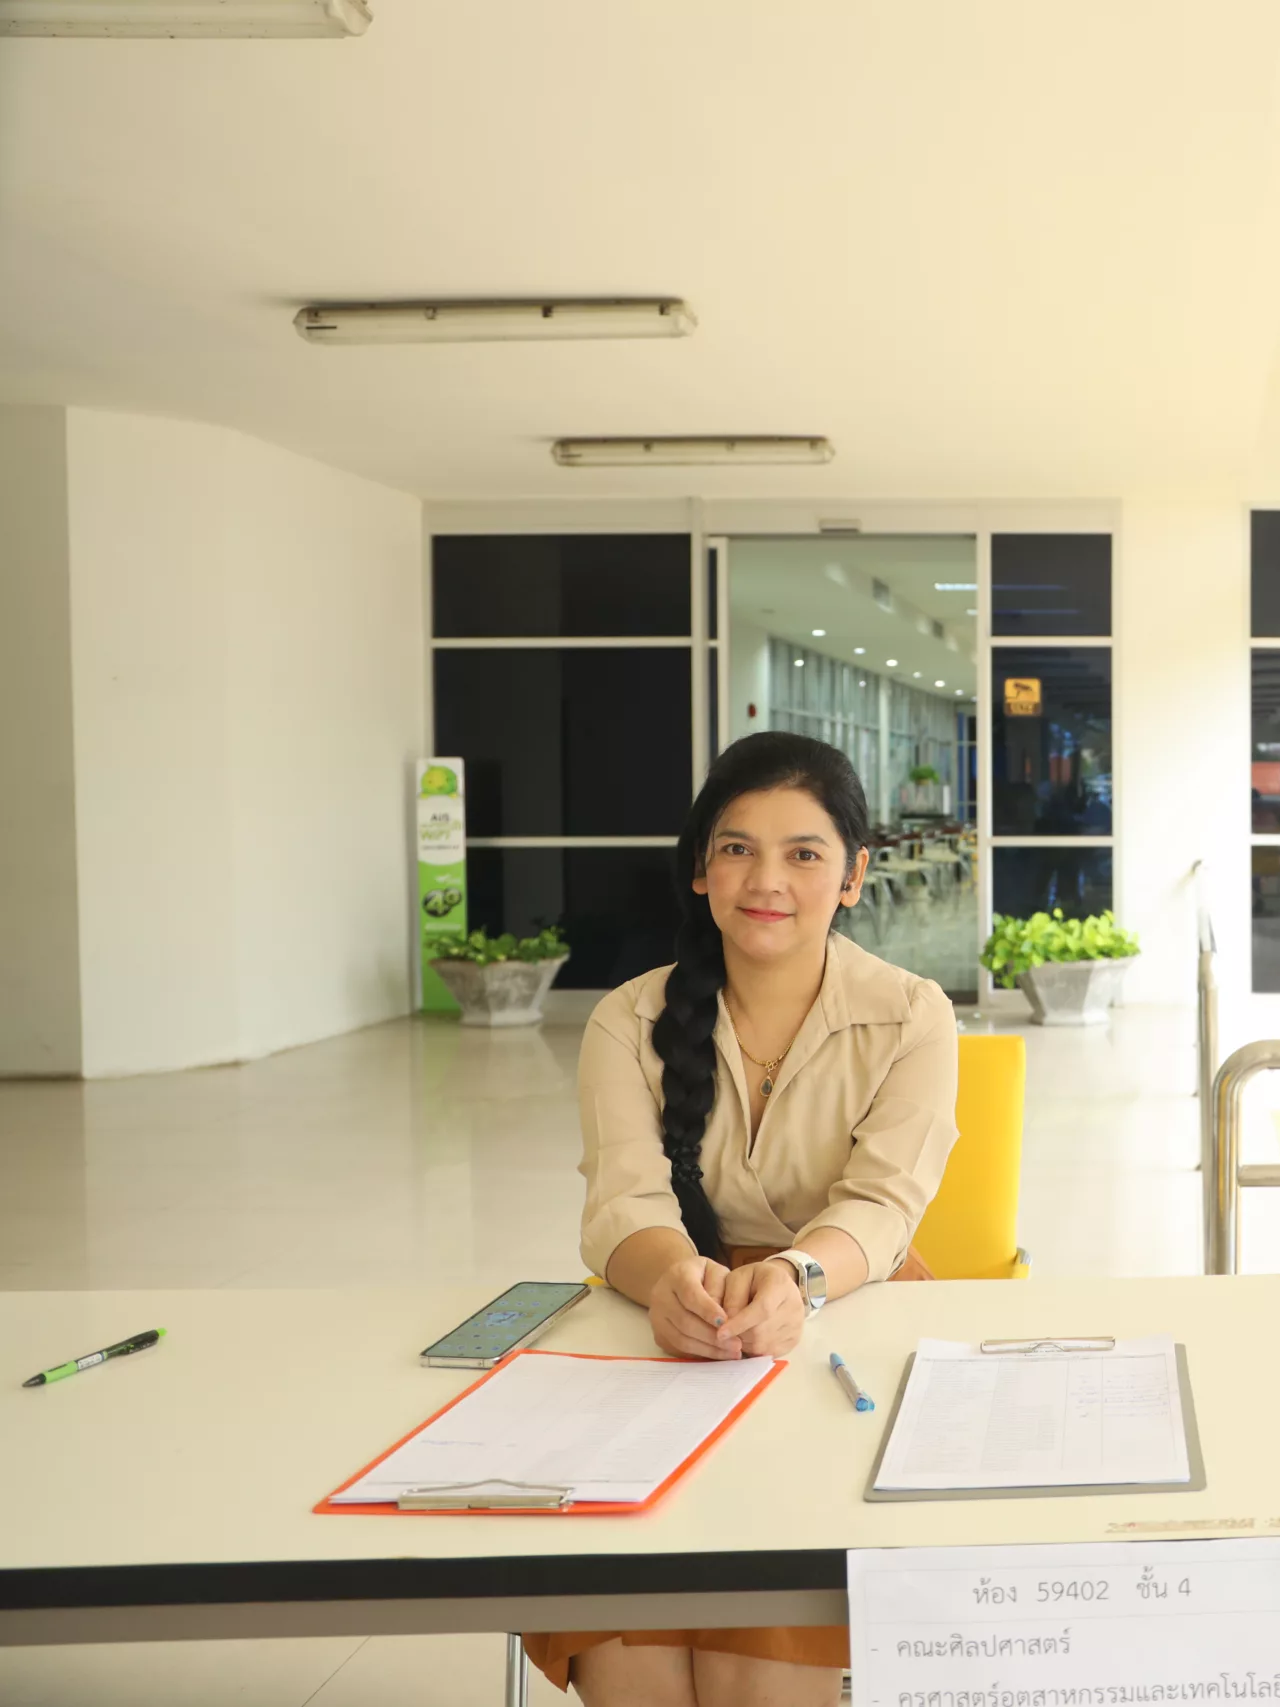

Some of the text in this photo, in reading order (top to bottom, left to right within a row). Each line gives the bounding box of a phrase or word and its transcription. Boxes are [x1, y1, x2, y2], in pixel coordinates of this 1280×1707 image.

[972, 1565, 1192, 1605] ห้อง 59402 ชั้น 4
[896, 1627, 1071, 1659] คณะศิลปศาสตร์
